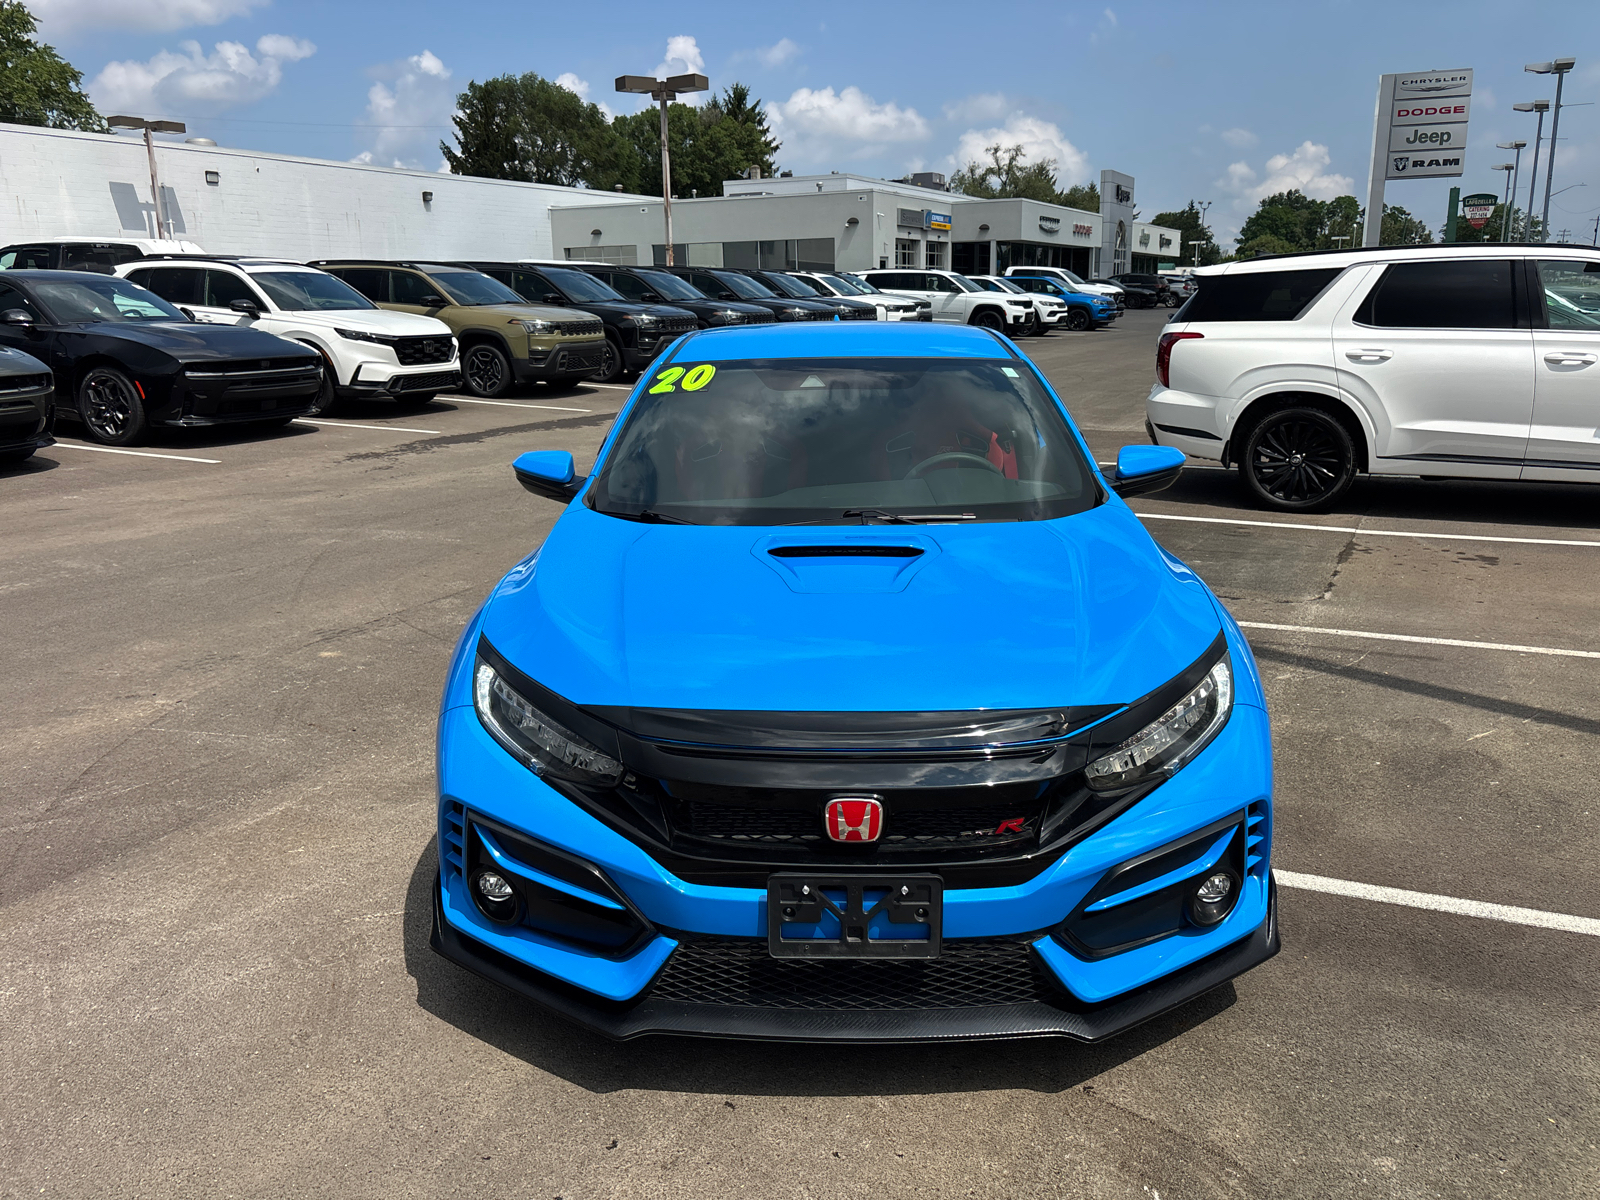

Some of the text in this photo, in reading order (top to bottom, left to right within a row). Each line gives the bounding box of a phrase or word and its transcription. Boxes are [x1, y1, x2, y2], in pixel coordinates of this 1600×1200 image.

[1401, 76, 1467, 86] CHRYSLER
[1397, 105, 1466, 117] DODGE
[1405, 129, 1452, 146] Jeep
[1411, 158, 1460, 168] RAM
[1468, 205, 1491, 213] CATERING
[648, 364, 717, 394] 20
[995, 817, 1025, 835] R
